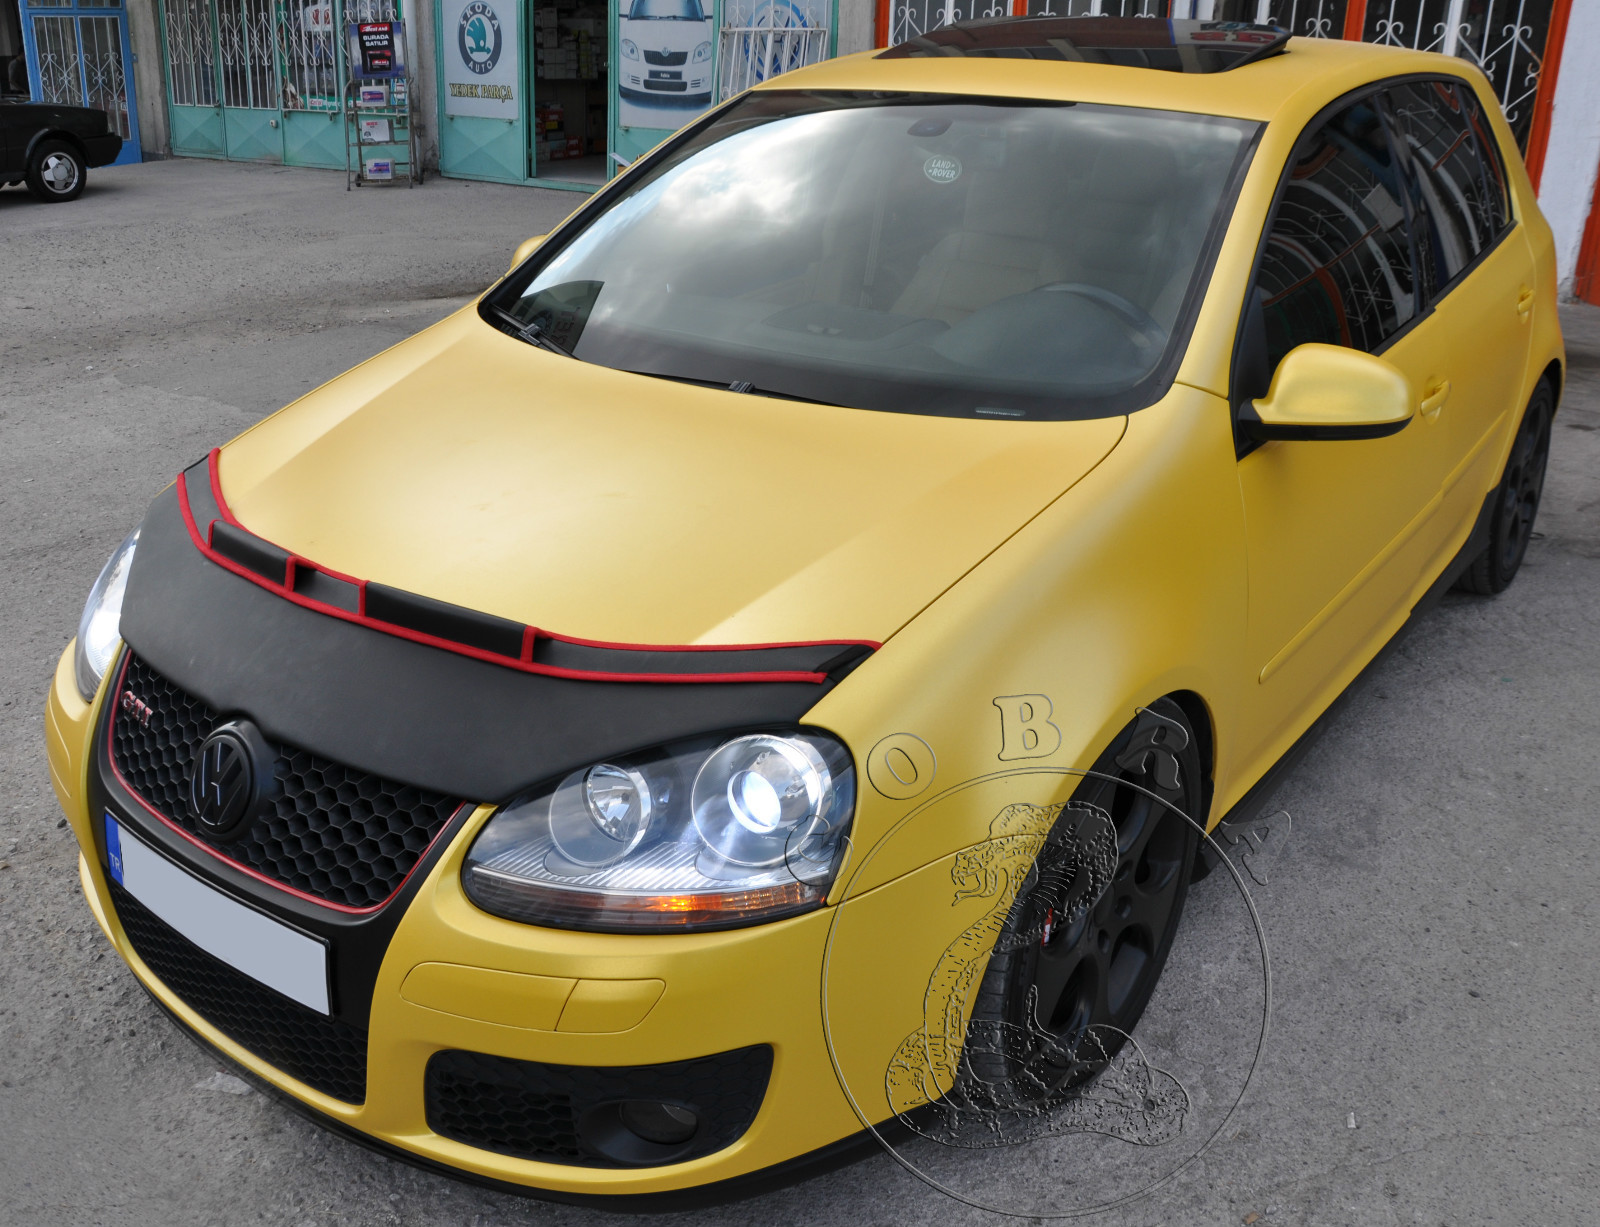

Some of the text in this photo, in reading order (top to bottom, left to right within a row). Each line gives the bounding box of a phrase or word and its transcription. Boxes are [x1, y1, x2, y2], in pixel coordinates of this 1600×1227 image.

[468, 60, 493, 73] AUTO
[449, 83, 514, 103] YEDEK PARÇA
[931, 159, 952, 169] LAND
[931, 168, 956, 179] ROVER
[121, 690, 154, 729] GTI
[109, 852, 121, 872] TR
